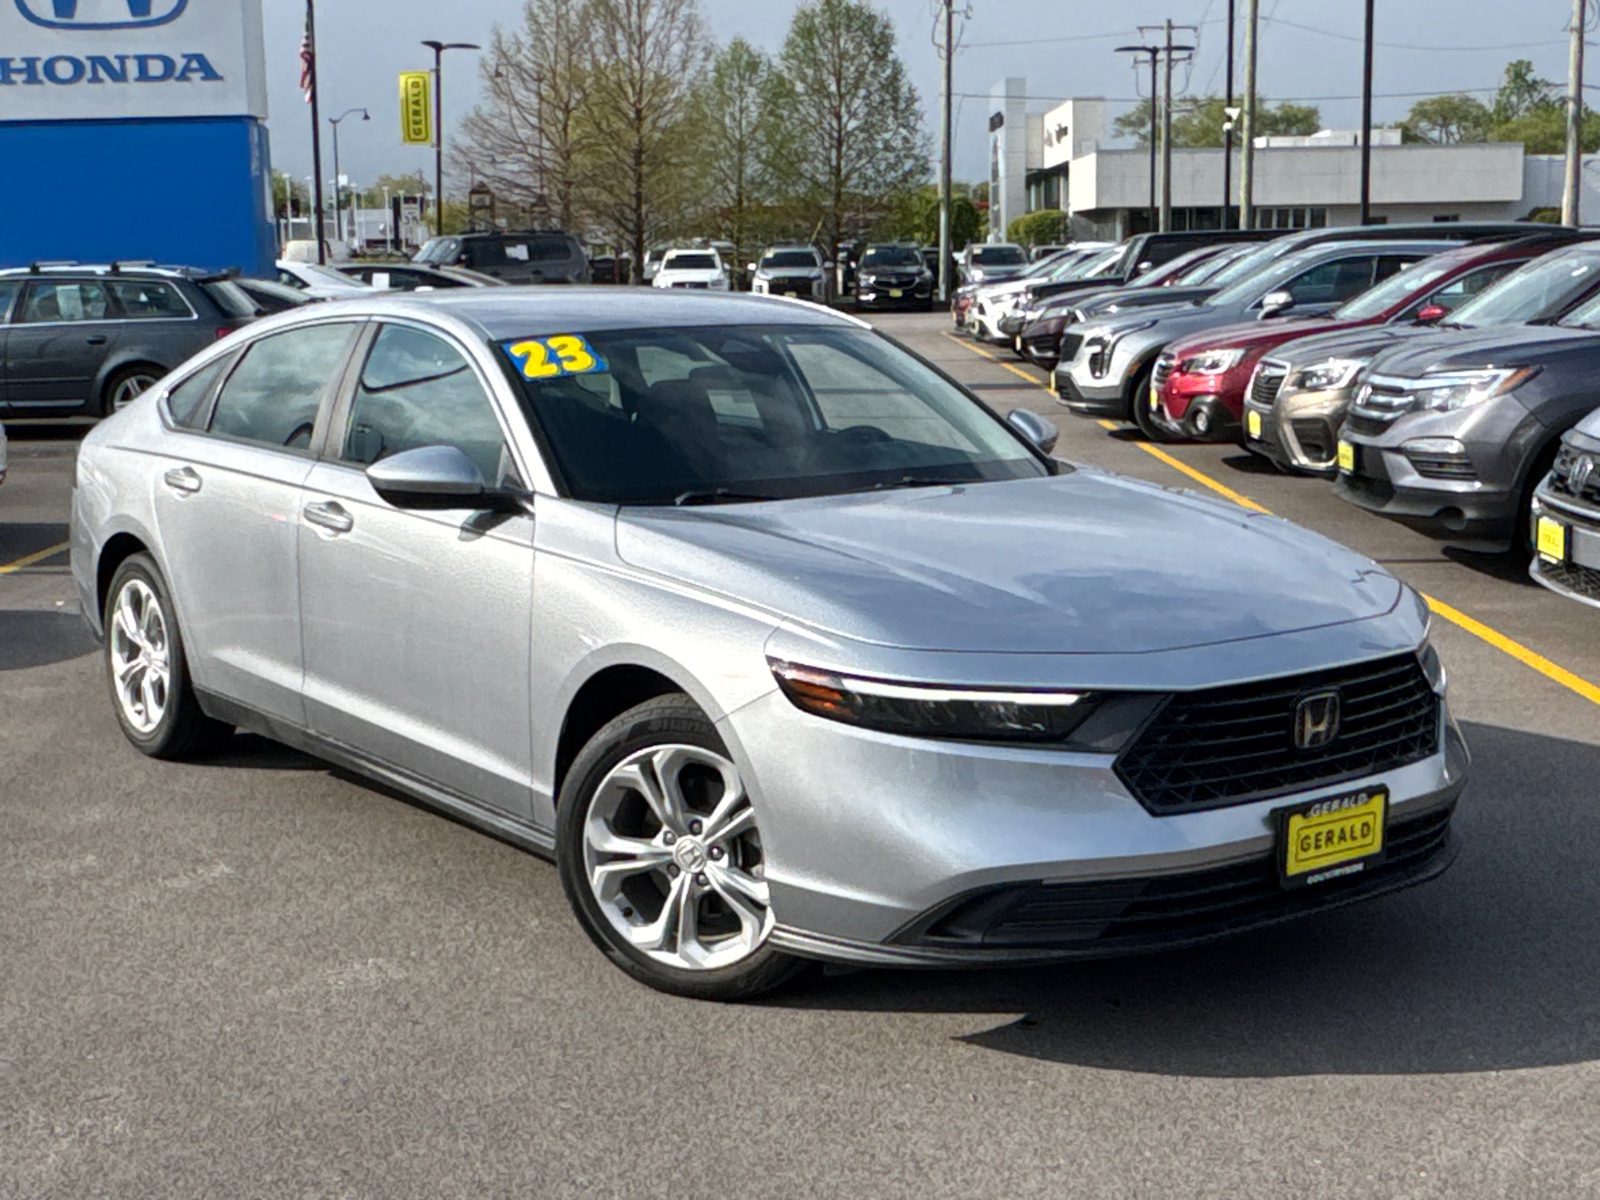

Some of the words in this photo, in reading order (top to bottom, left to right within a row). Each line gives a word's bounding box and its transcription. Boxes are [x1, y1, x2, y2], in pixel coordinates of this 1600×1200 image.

[0, 53, 224, 85] HONDA
[410, 80, 423, 137] GERALD
[509, 334, 595, 378] 23
[1300, 821, 1371, 852] GERALD
